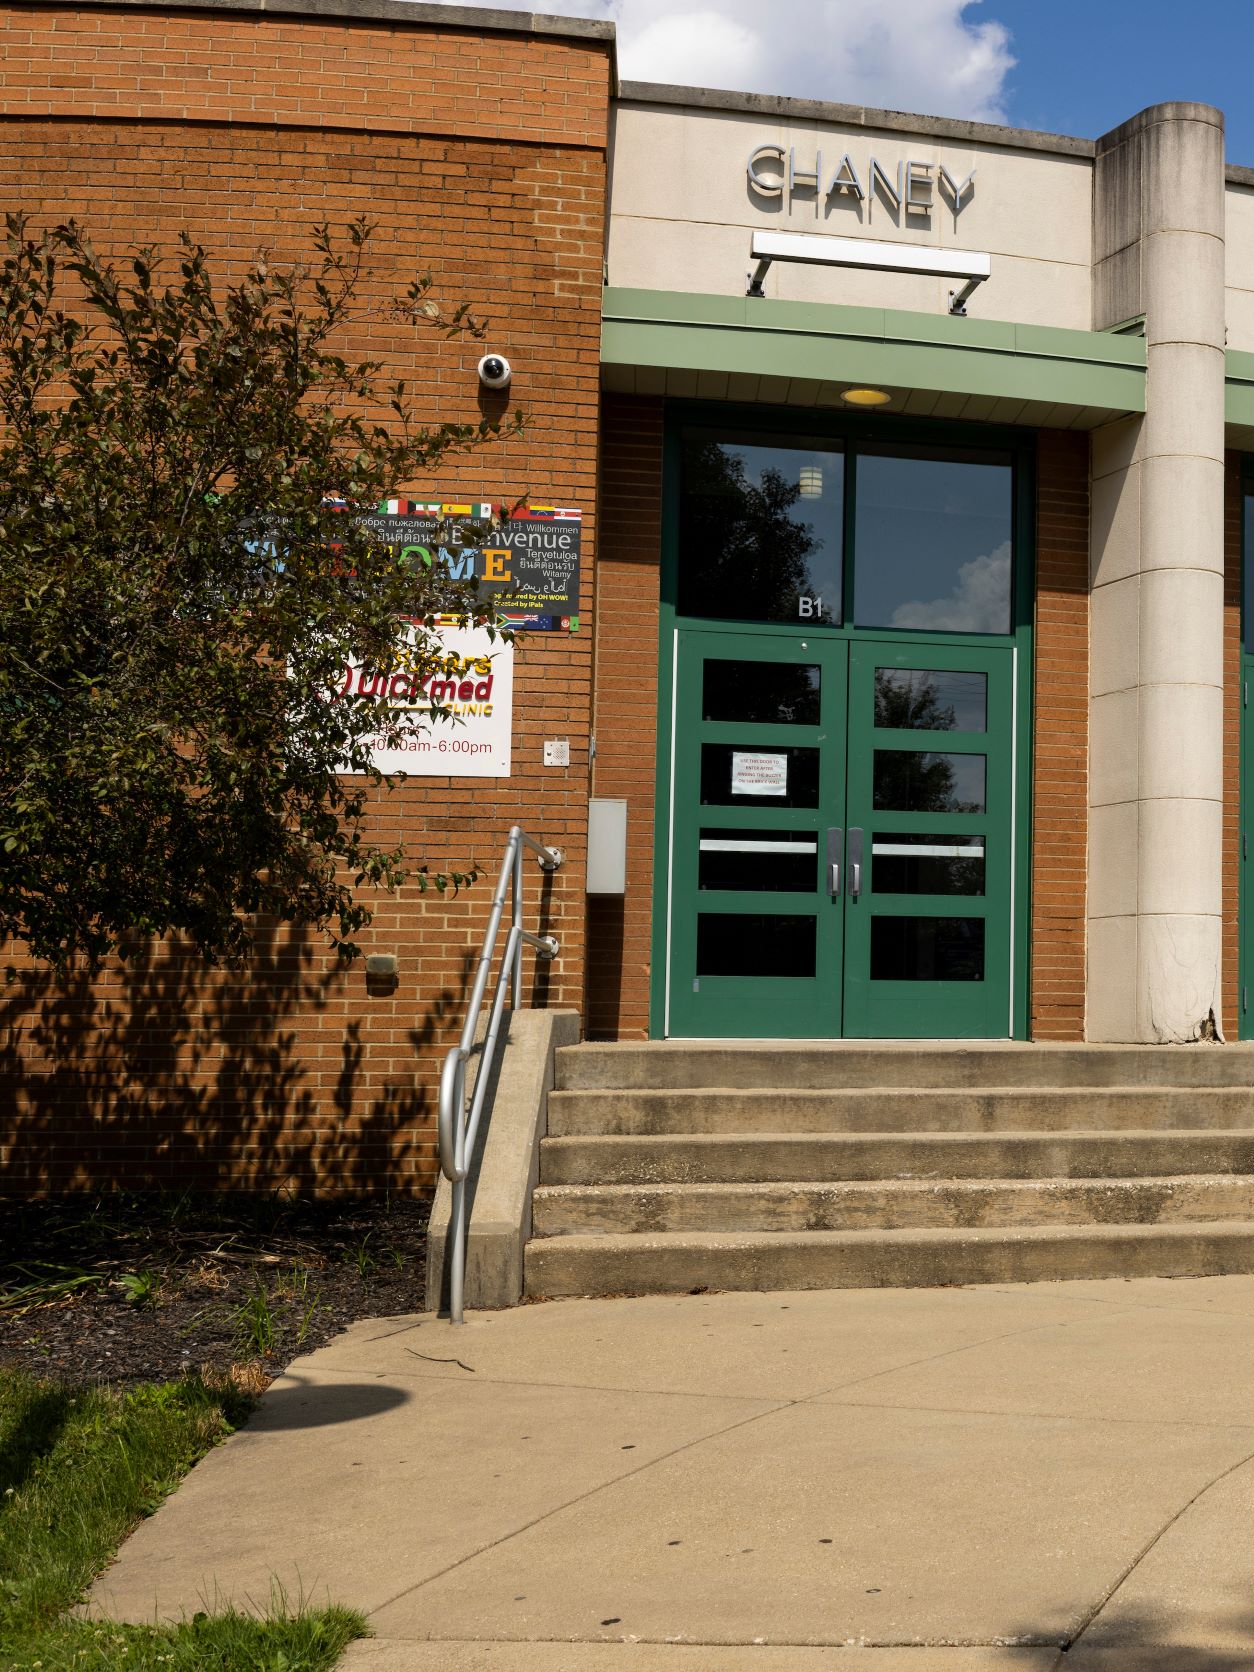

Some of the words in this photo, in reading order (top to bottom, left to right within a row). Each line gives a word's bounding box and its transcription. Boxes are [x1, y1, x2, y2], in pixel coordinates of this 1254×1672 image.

[747, 143, 977, 208] CHANEY
[526, 524, 578, 534] Willkommen
[452, 525, 571, 549] Bnvenue
[526, 549, 578, 560] Tervetuloa
[542, 570, 571, 580] Witamy
[799, 596, 822, 616] B1
